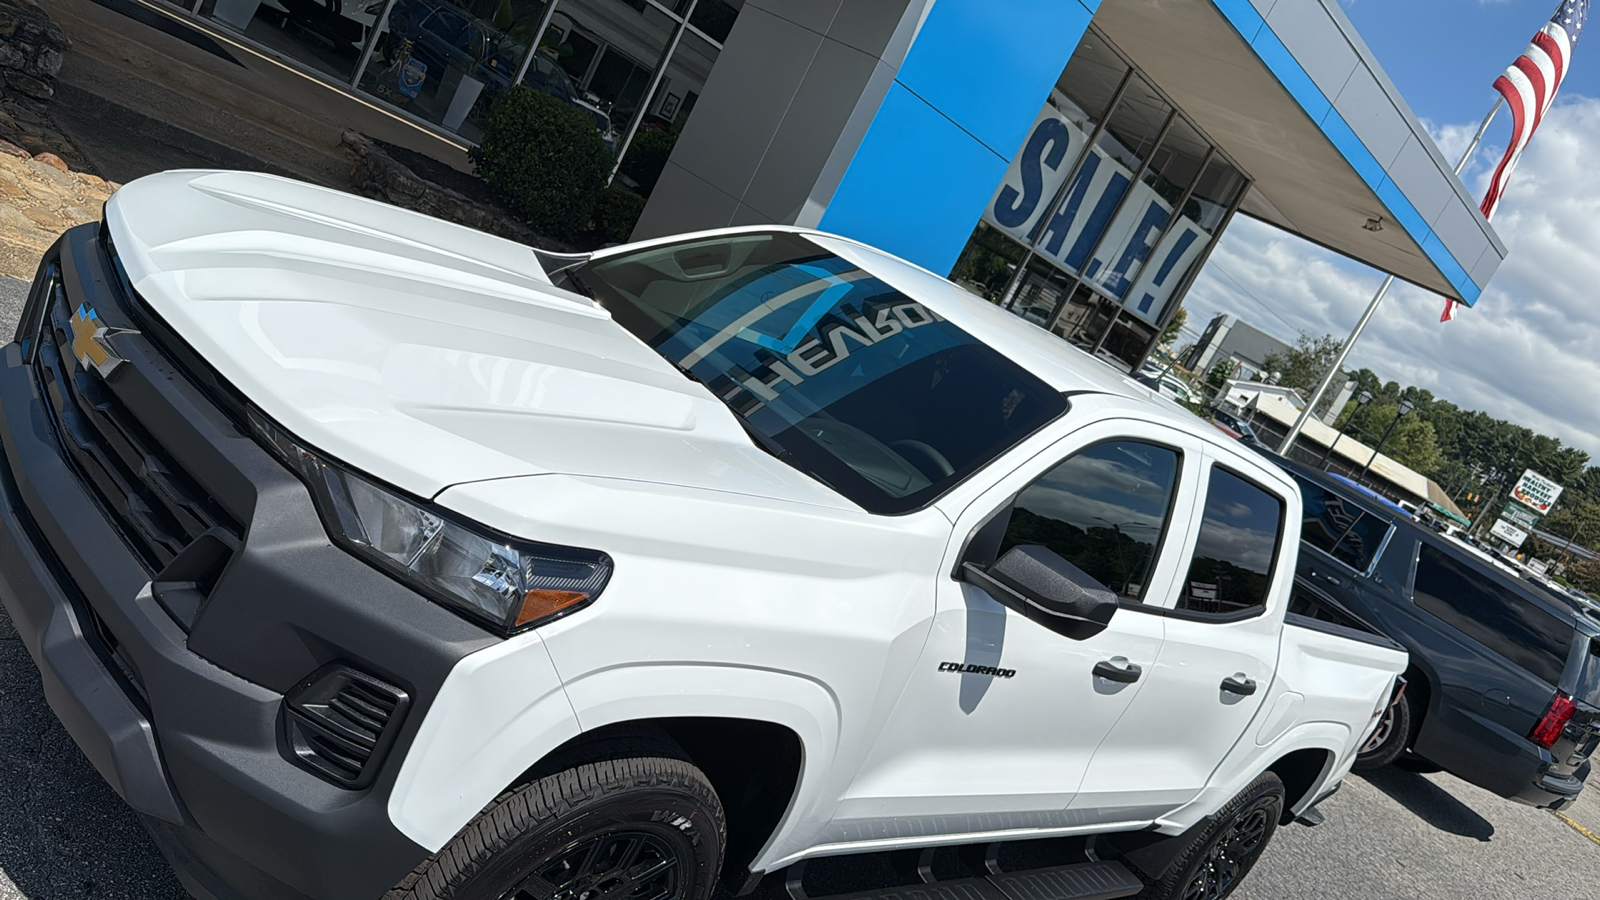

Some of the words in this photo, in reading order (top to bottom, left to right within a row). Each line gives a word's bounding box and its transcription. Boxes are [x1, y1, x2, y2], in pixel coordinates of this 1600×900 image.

[994, 117, 1198, 314] SALE!
[1522, 476, 1551, 492] HEALTHY
[1522, 482, 1552, 500] HARVEST
[1521, 488, 1551, 506] PRODUCE
[938, 662, 1017, 679] COLORADO
